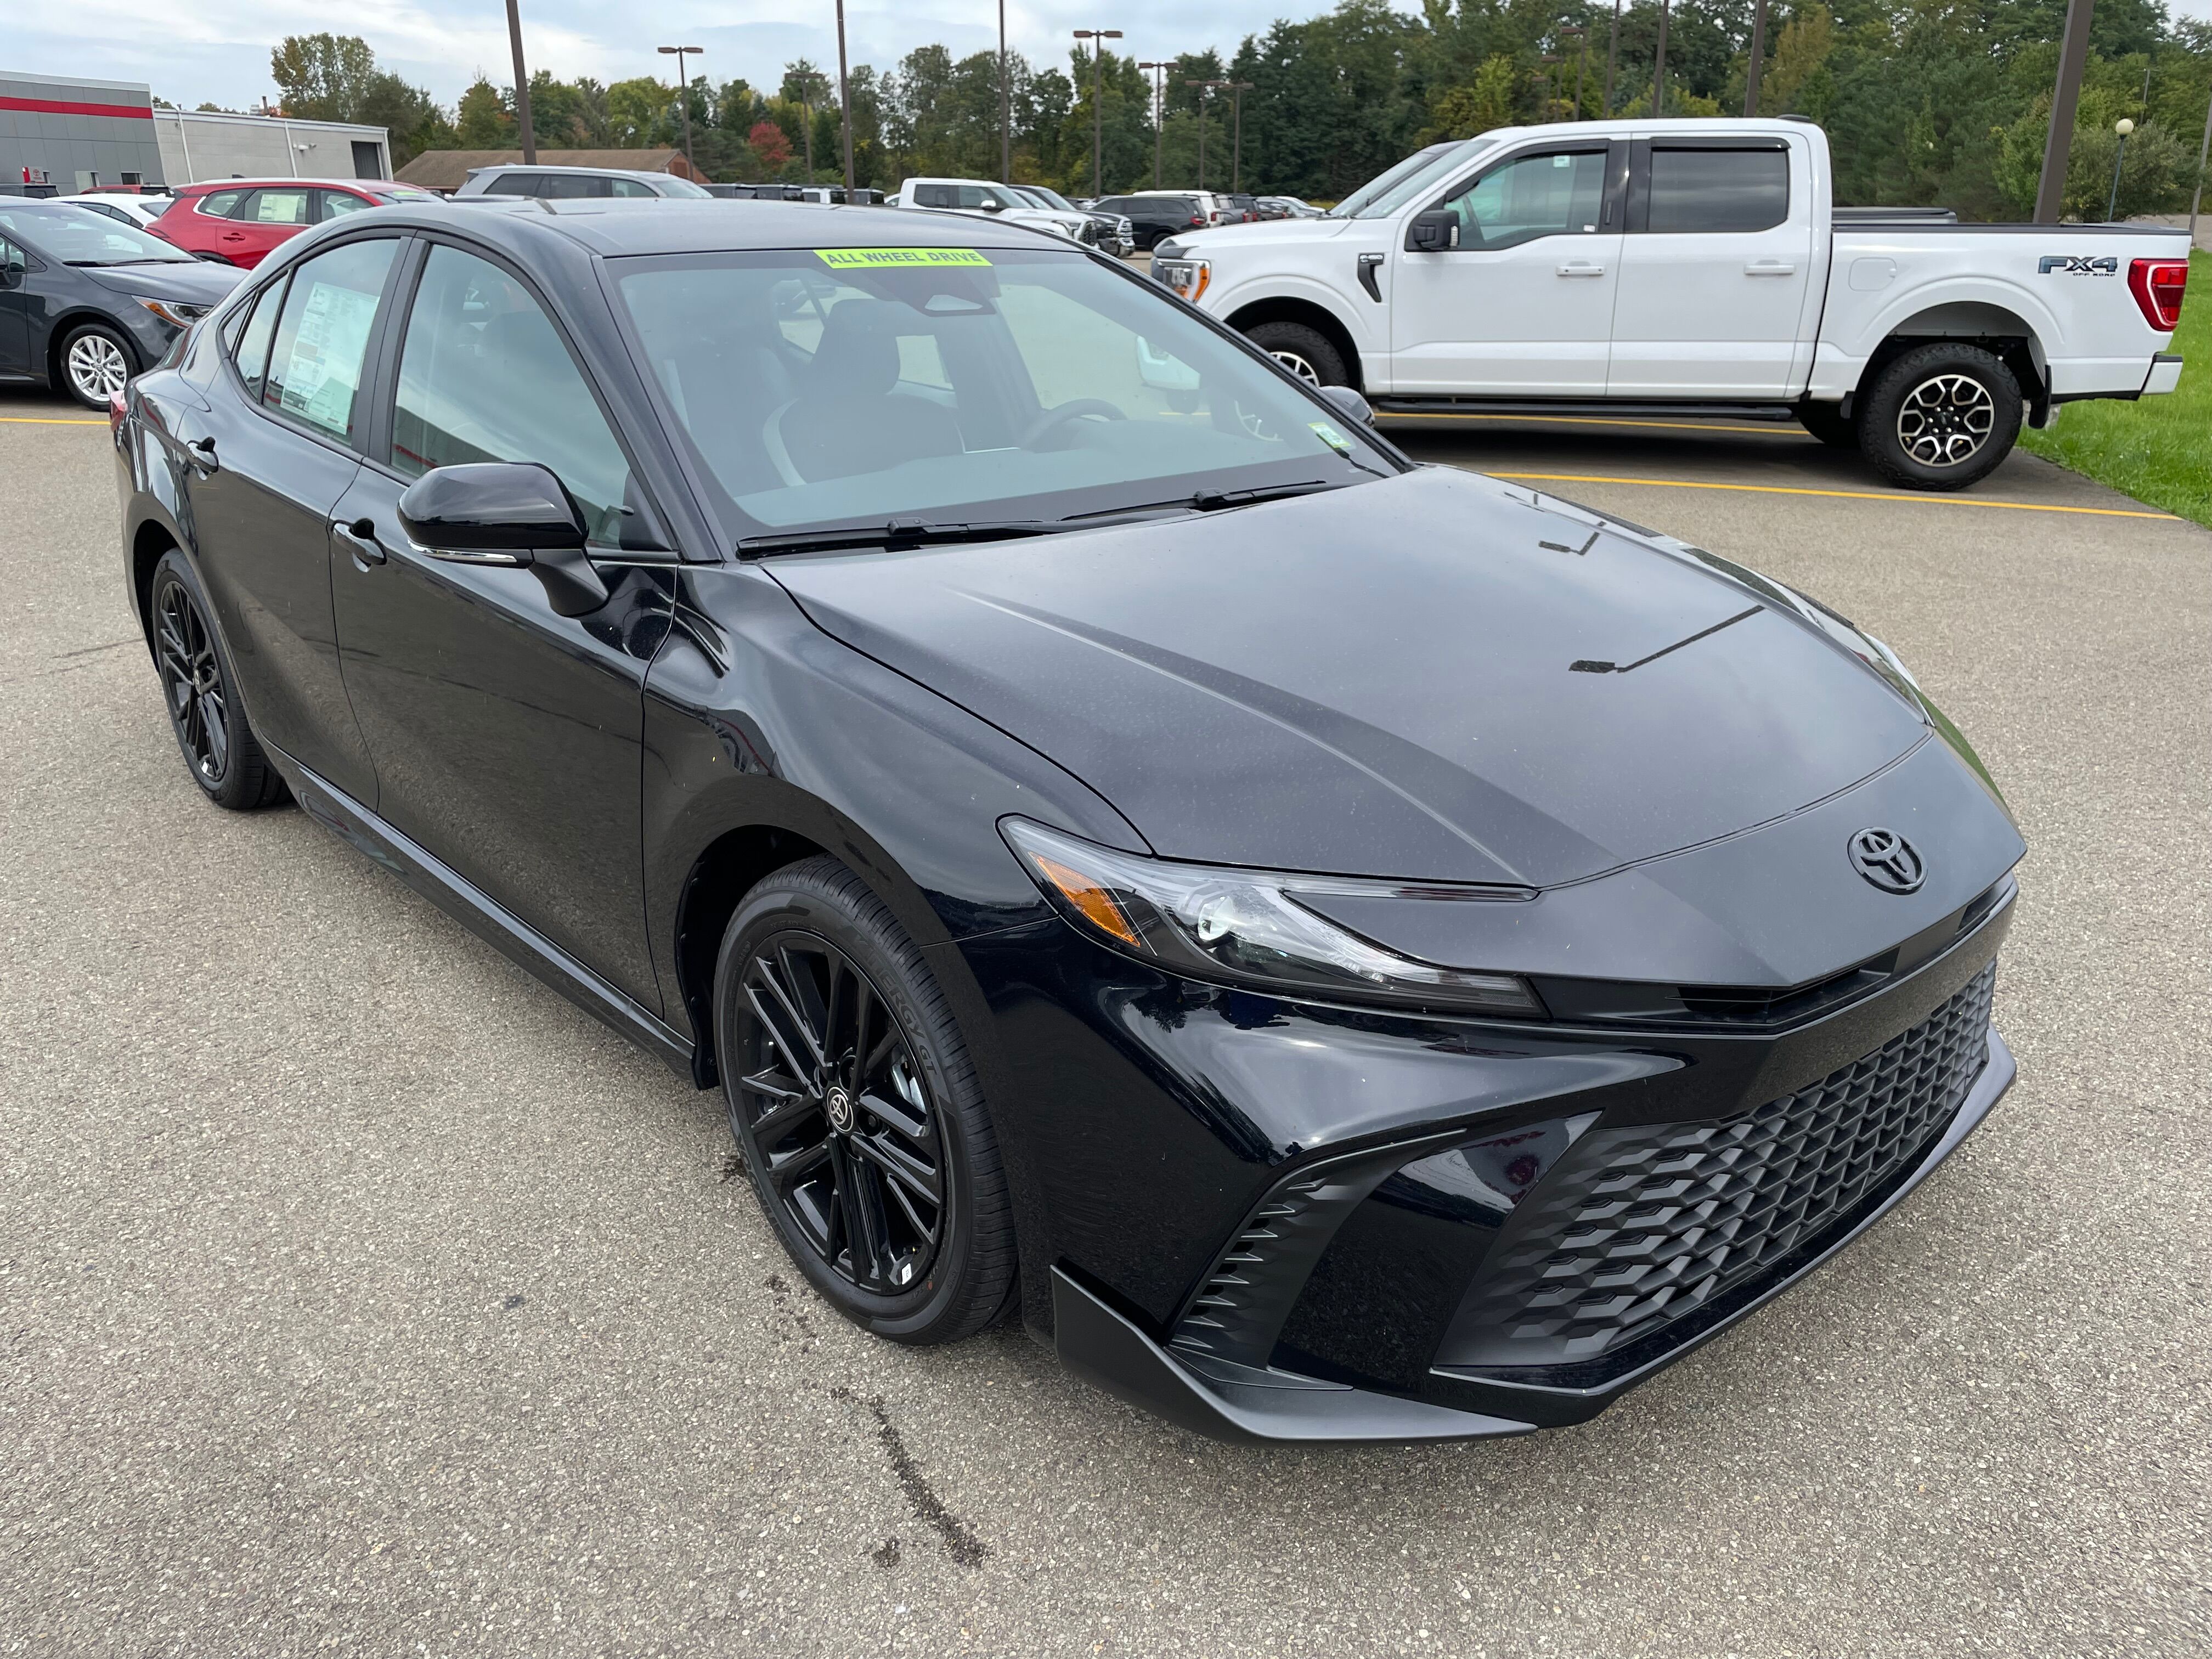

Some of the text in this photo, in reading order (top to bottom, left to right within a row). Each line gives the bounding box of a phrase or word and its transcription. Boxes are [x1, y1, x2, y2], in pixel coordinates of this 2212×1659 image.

[826, 252, 983, 264] ALL WHEEL DRIVE
[2038, 256, 2118, 273] FX4
[918, 1044, 938, 1075] GT
